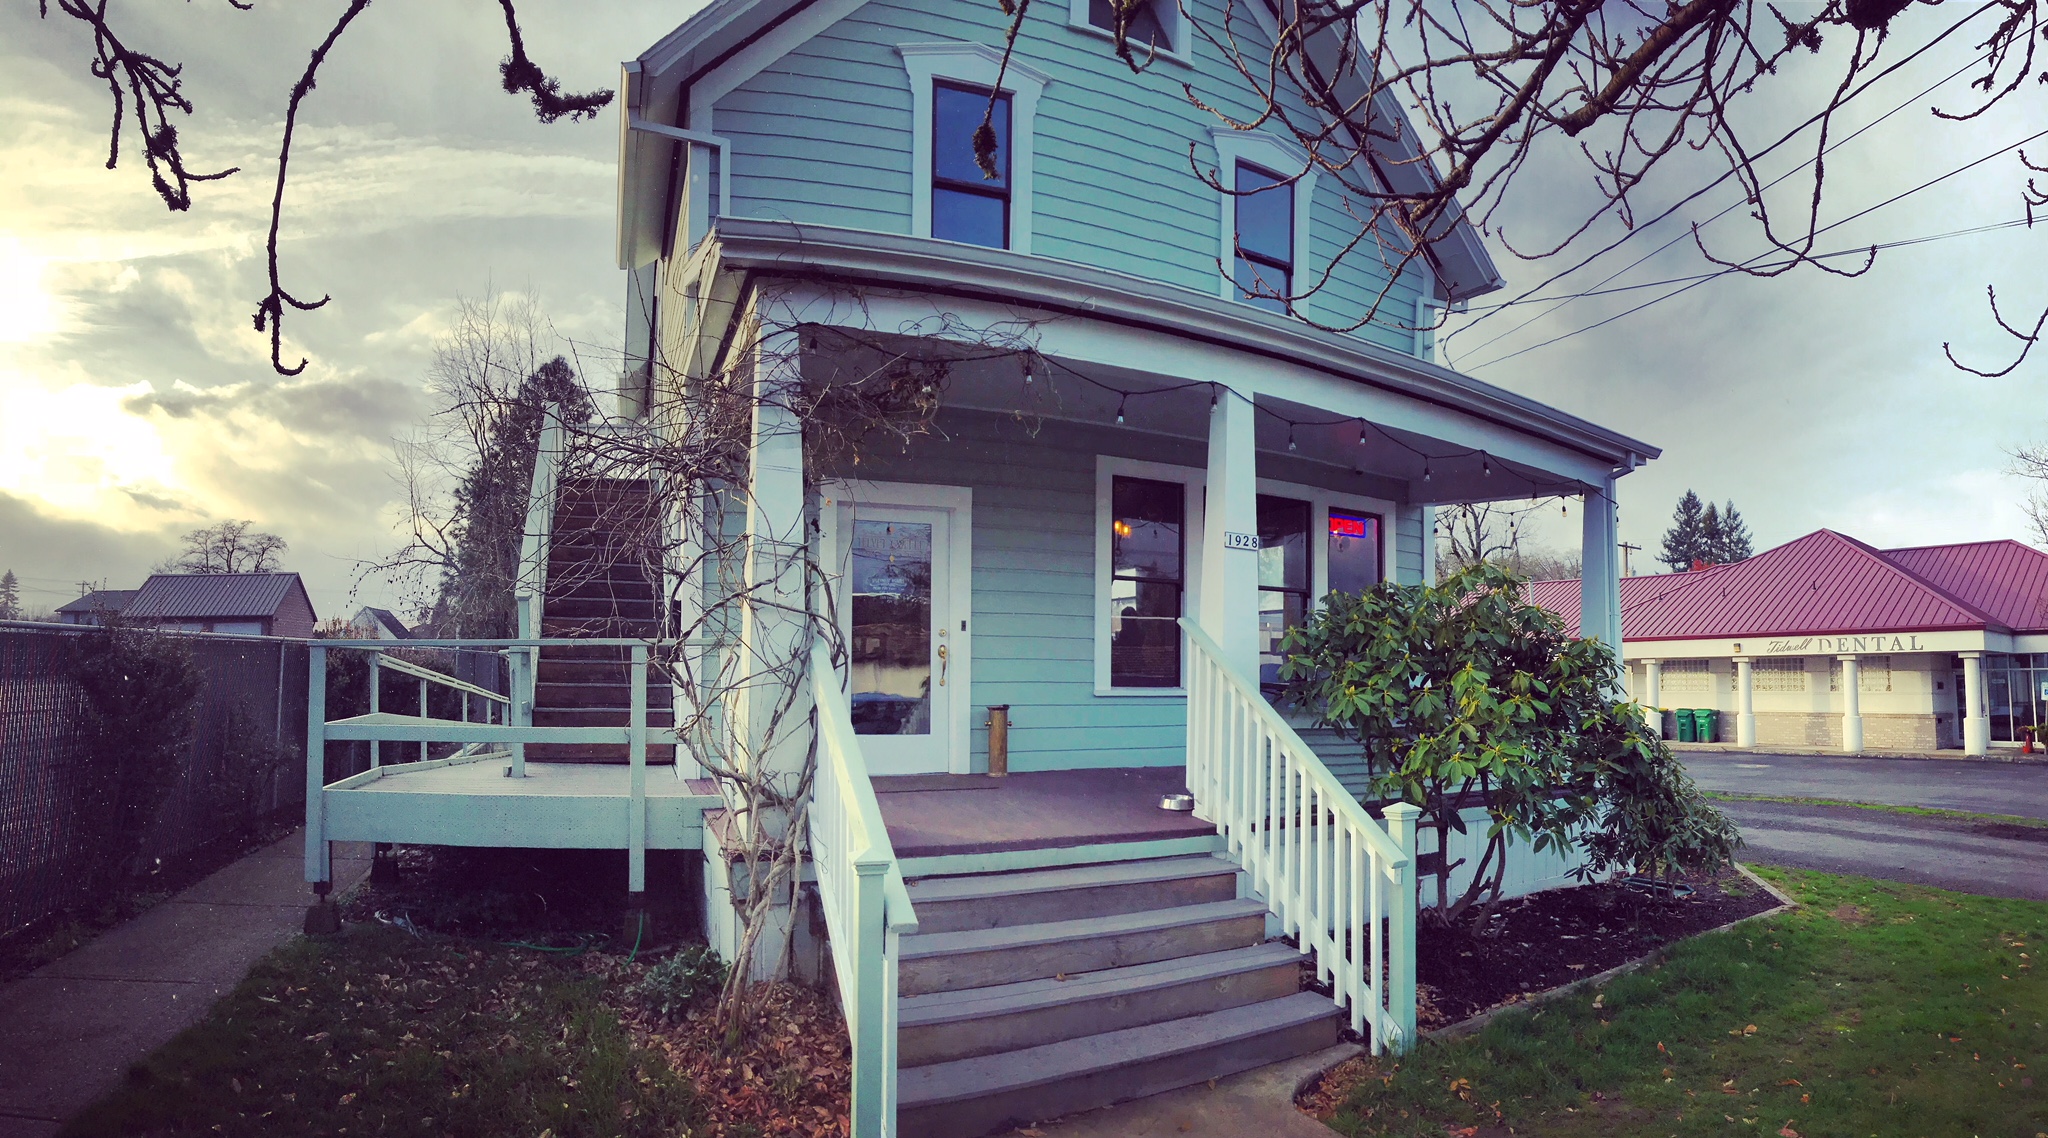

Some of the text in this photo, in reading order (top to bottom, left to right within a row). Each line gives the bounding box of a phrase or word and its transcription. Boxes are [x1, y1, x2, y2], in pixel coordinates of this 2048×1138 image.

[1228, 534, 1258, 548] 1928
[1766, 635, 1924, 654] Tidwell DENTAL
